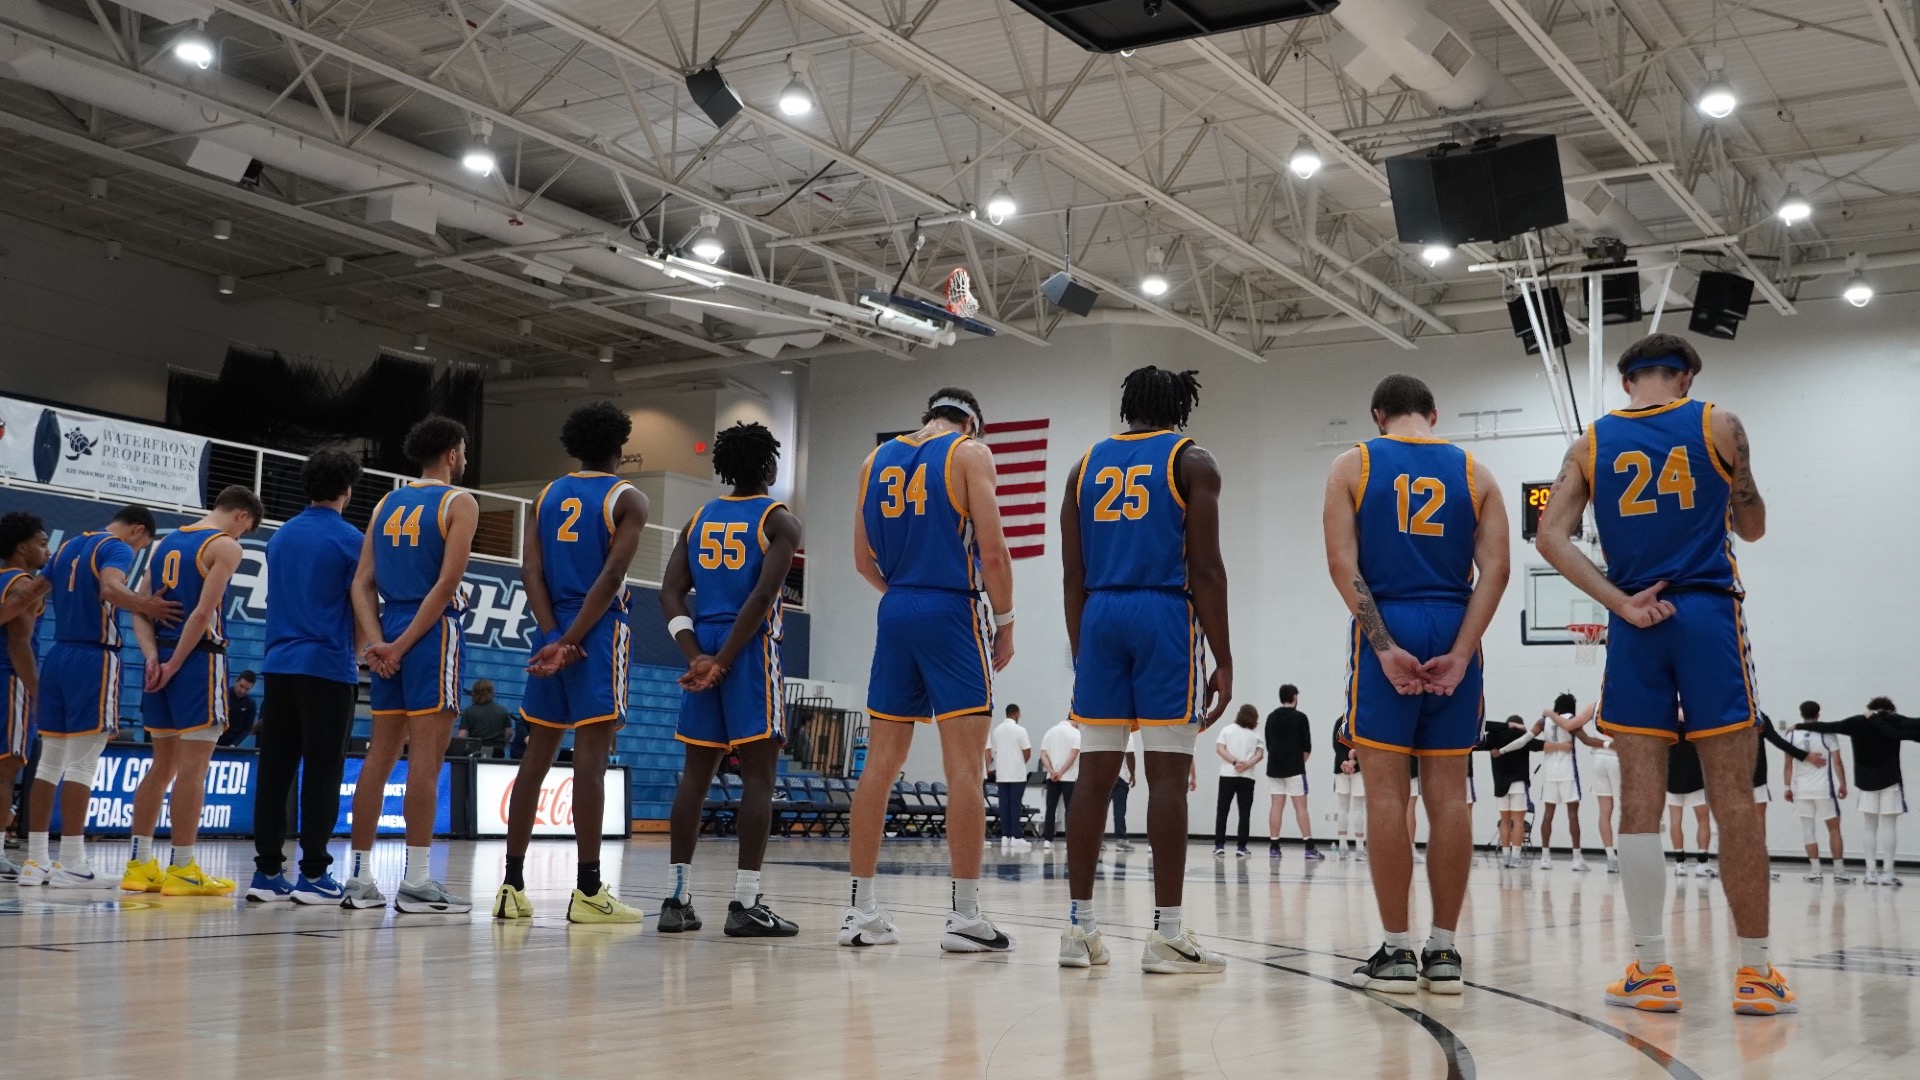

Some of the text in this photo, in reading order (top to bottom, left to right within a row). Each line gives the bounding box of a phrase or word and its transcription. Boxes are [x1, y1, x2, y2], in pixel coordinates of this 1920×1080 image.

[102, 445, 196, 472] PROPERTIES
[103, 429, 199, 458] WATERFRONT
[78, 469, 105, 479] PARKWAY
[101, 461, 118, 469] AND
[1613, 446, 1695, 517] 24
[879, 463, 928, 518] 34
[1093, 464, 1153, 522] 25
[1394, 473, 1446, 537] 12
[383, 505, 425, 547] 44
[556, 497, 582, 542] 2
[698, 521, 749, 570] 55
[68, 555, 81, 592] 1
[162, 550, 181, 589] 0
